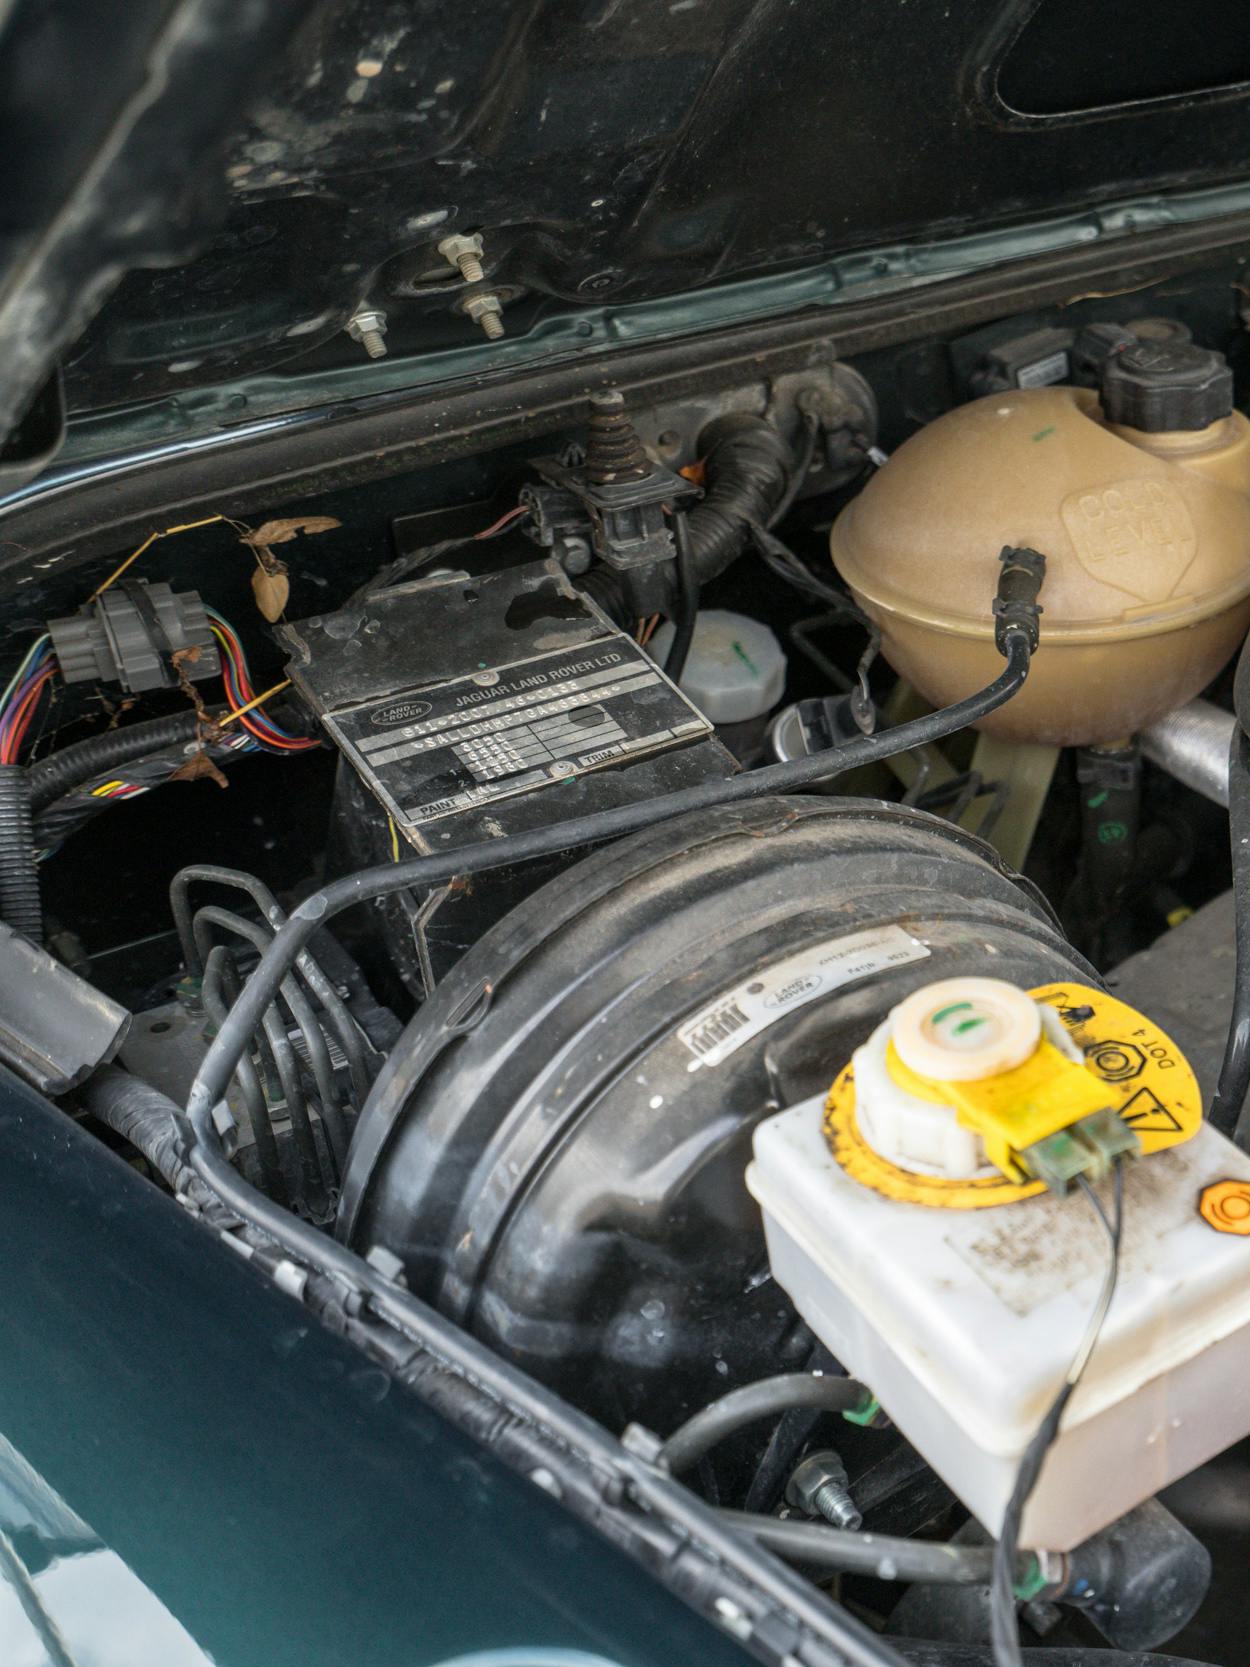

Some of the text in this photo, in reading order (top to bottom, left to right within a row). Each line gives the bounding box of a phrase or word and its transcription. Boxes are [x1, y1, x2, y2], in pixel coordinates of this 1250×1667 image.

[1080, 480, 1167, 520] COLD
[1084, 518, 1194, 561] LEVEL
[455, 653, 621, 707] JAGUAR LAND ROVER LTD
[382, 705, 411, 718] LAND
[387, 707, 424, 721] ROVER
[583, 749, 615, 765] TRIM
[420, 798, 457, 816] PAINT
[1140, 1040, 1176, 1069] DOT
